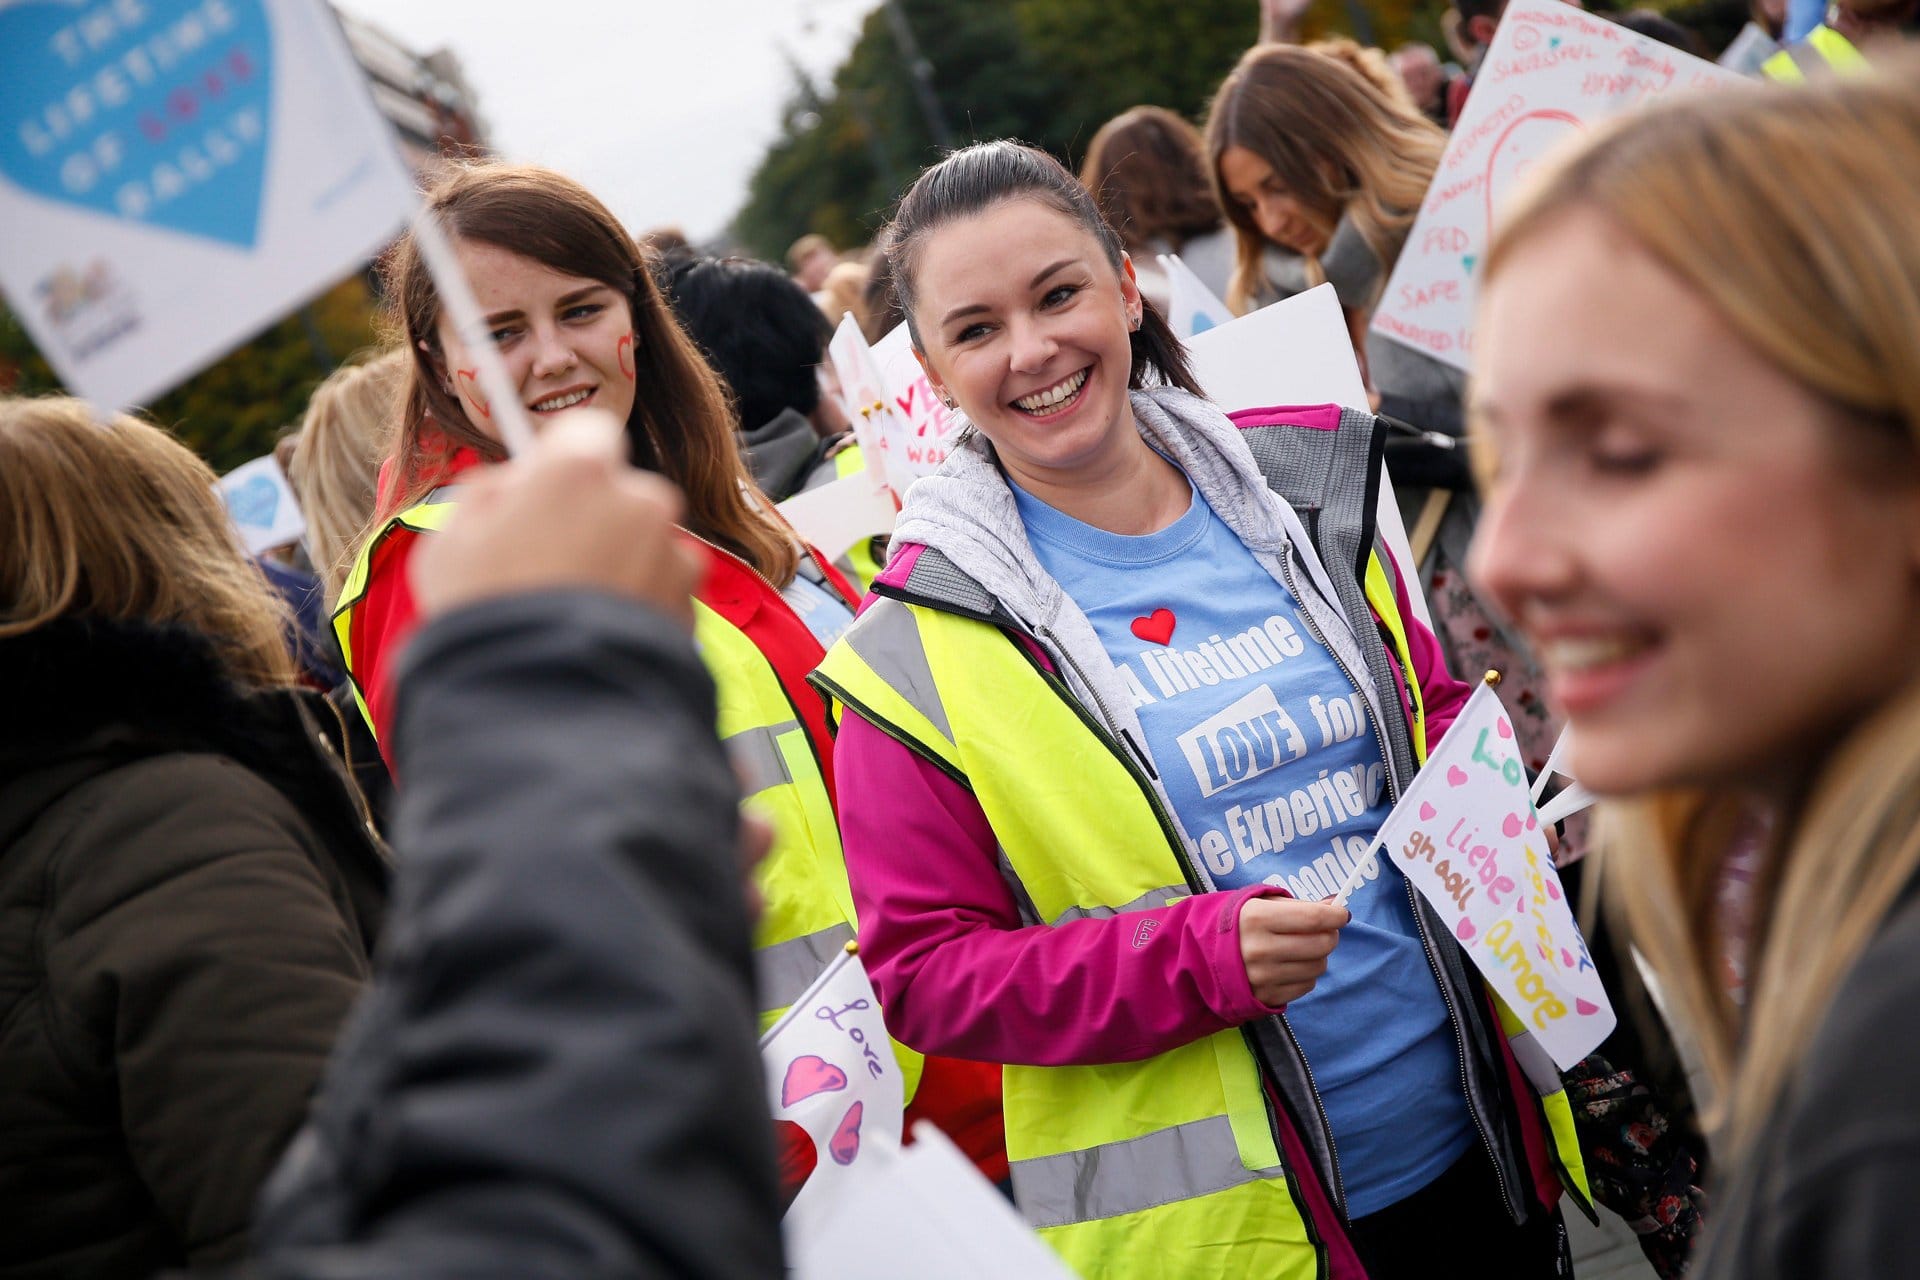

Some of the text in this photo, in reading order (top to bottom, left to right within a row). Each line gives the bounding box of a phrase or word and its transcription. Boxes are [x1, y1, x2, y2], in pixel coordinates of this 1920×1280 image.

[1139, 615, 1305, 700] lifetime
[1196, 690, 1368, 789] LOVE for
[1224, 761, 1385, 865] Experienc
